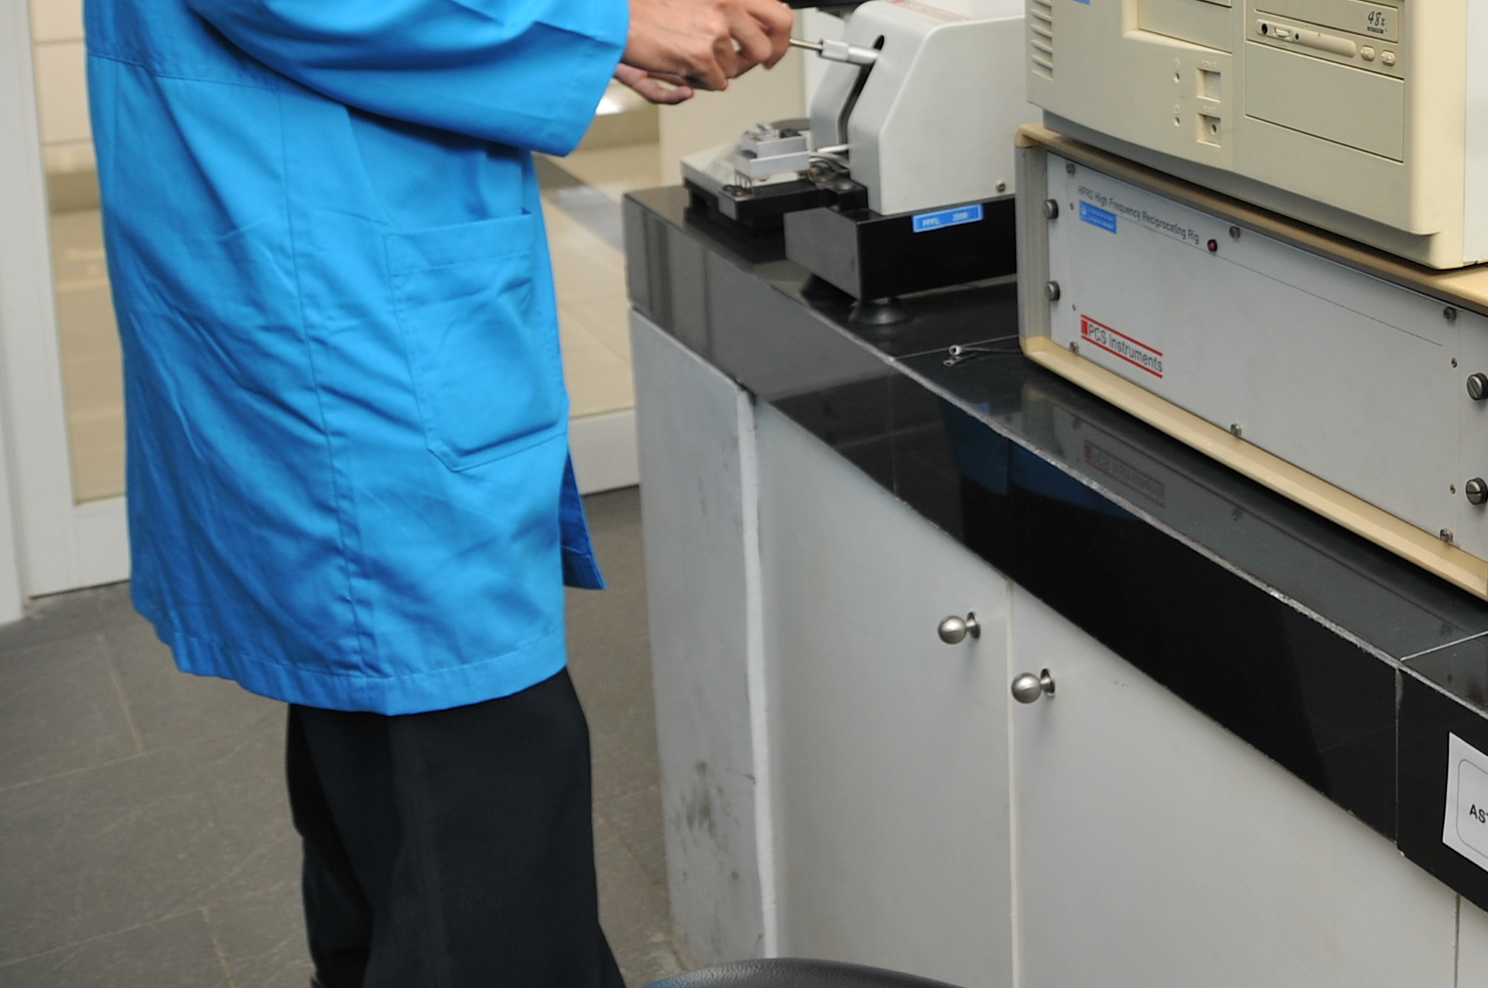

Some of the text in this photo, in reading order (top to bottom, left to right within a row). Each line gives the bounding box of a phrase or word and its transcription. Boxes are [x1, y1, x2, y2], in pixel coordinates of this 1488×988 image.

[1095, 193, 1107, 207] High
[1109, 198, 1140, 221] Frequency
[1142, 211, 1186, 240] Reciprocating
[1188, 229, 1199, 245] Rig
[1088, 323, 1162, 372] PCS Instruments
